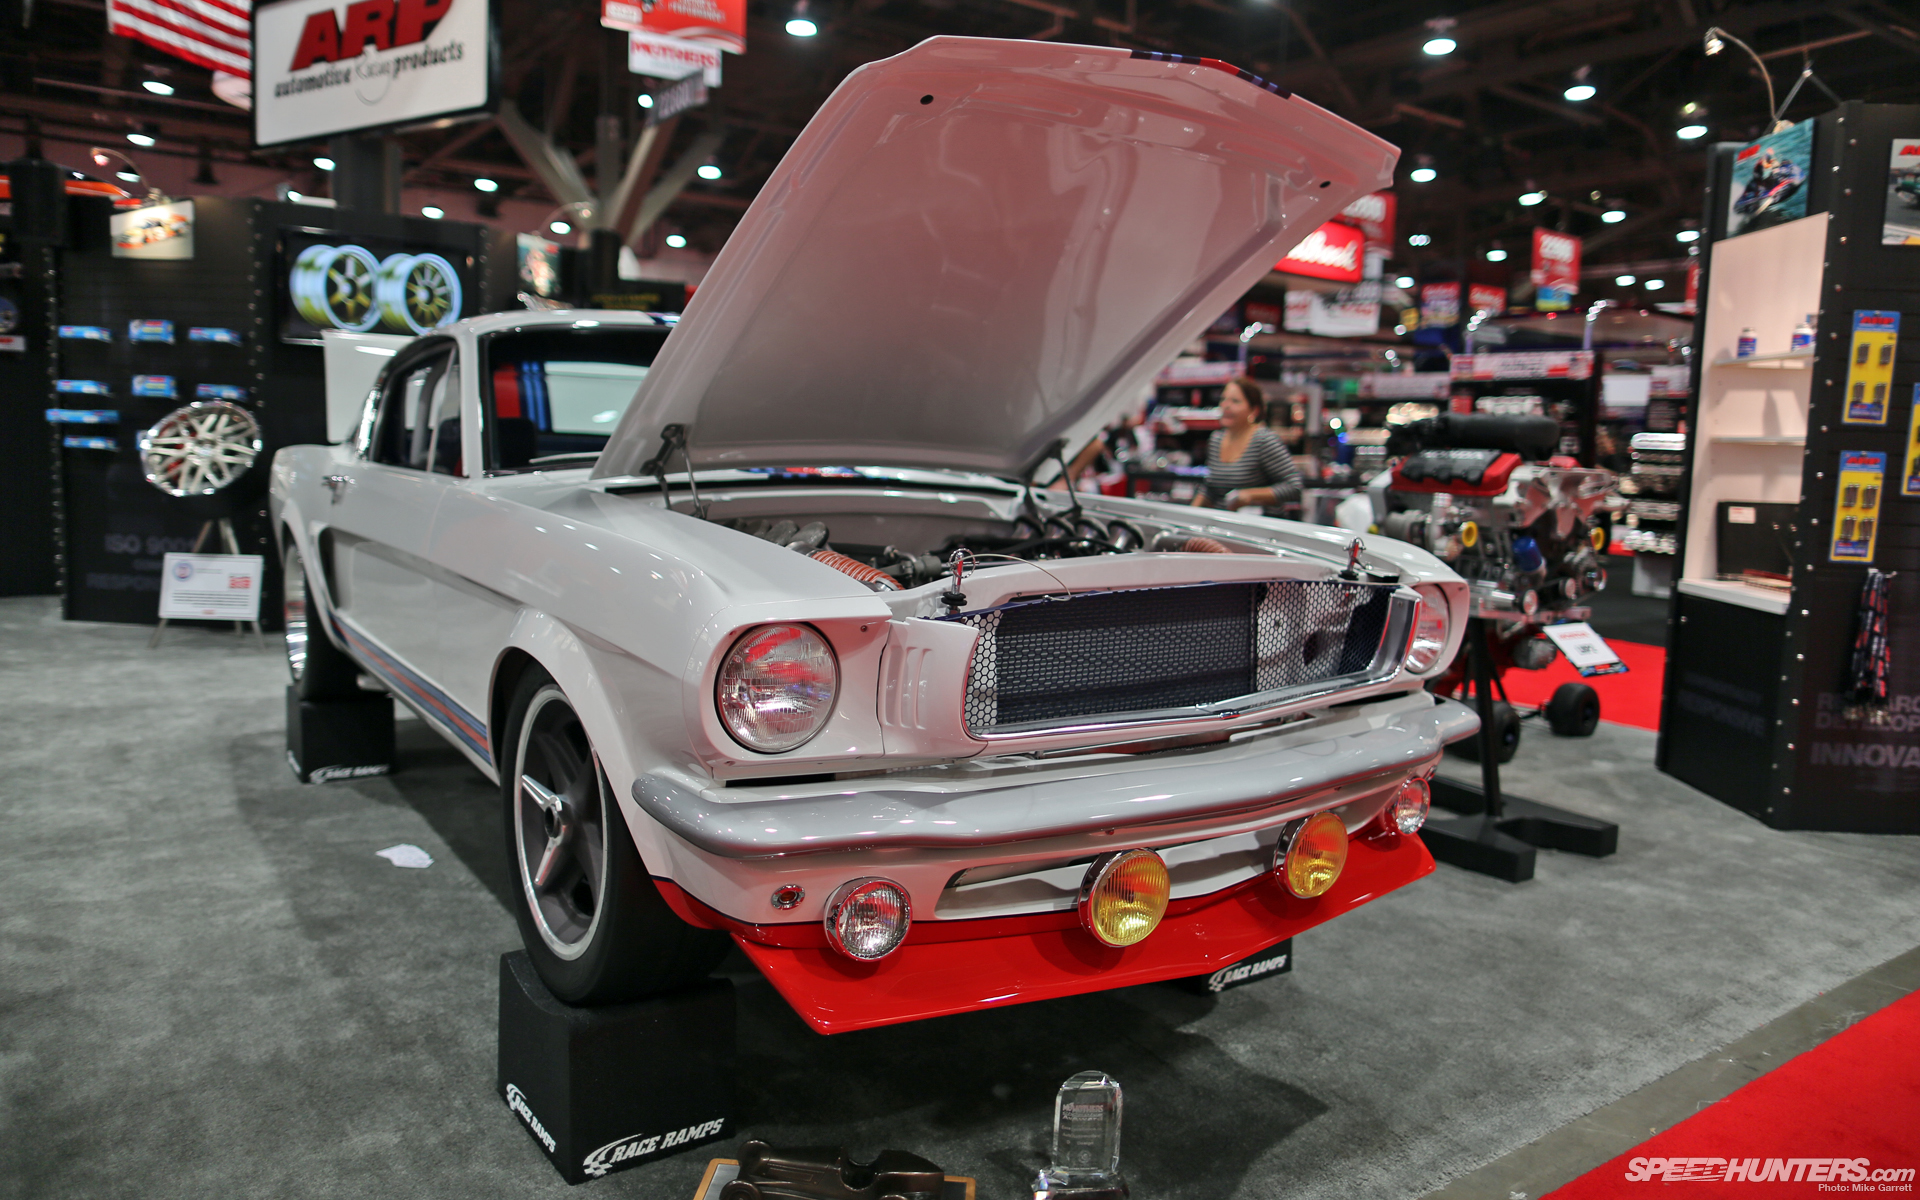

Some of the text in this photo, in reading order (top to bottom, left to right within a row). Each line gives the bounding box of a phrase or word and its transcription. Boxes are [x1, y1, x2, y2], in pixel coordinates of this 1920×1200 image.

[289, 0, 458, 72] ARP
[275, 63, 352, 98] automotive
[392, 41, 465, 79] products
[531, 1115, 557, 1153] RAMPS
[610, 1118, 725, 1164] RACE RAMPS
